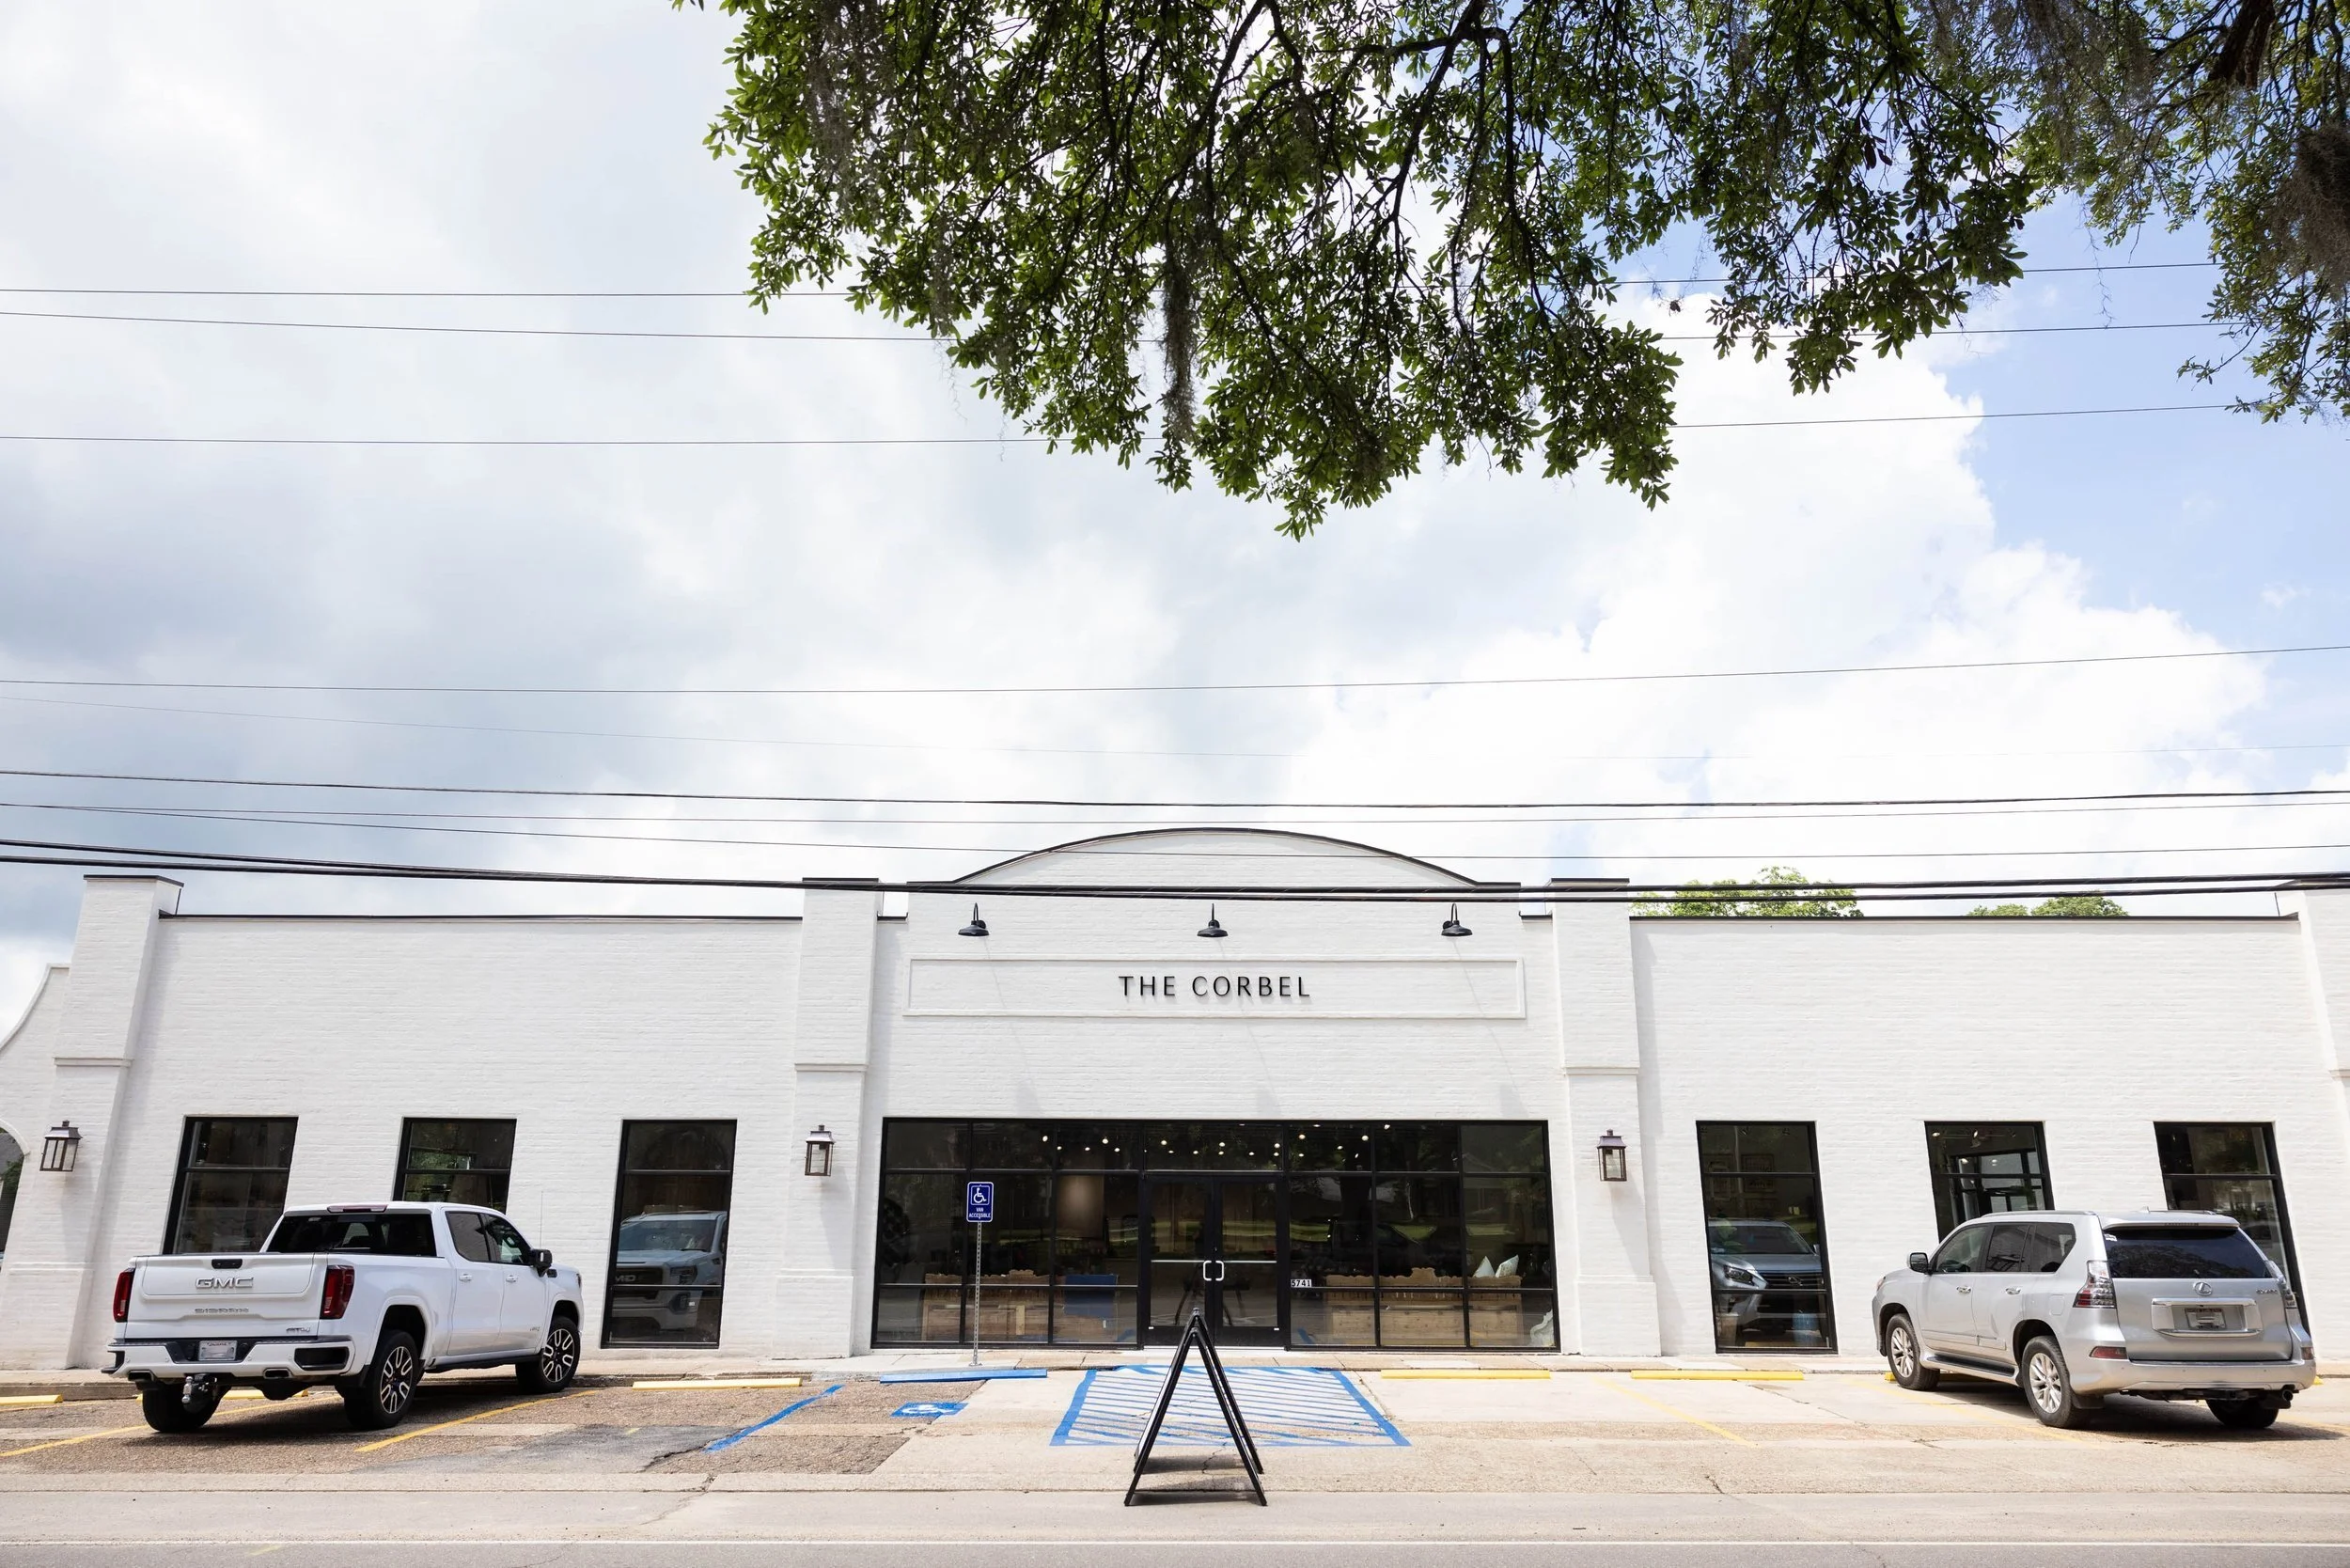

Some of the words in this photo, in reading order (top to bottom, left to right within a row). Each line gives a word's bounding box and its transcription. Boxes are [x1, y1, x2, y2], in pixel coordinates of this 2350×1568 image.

[1118, 976, 1176, 996] THE
[1192, 975, 1310, 996] CORBEL
[195, 1277, 254, 1289] GMC
